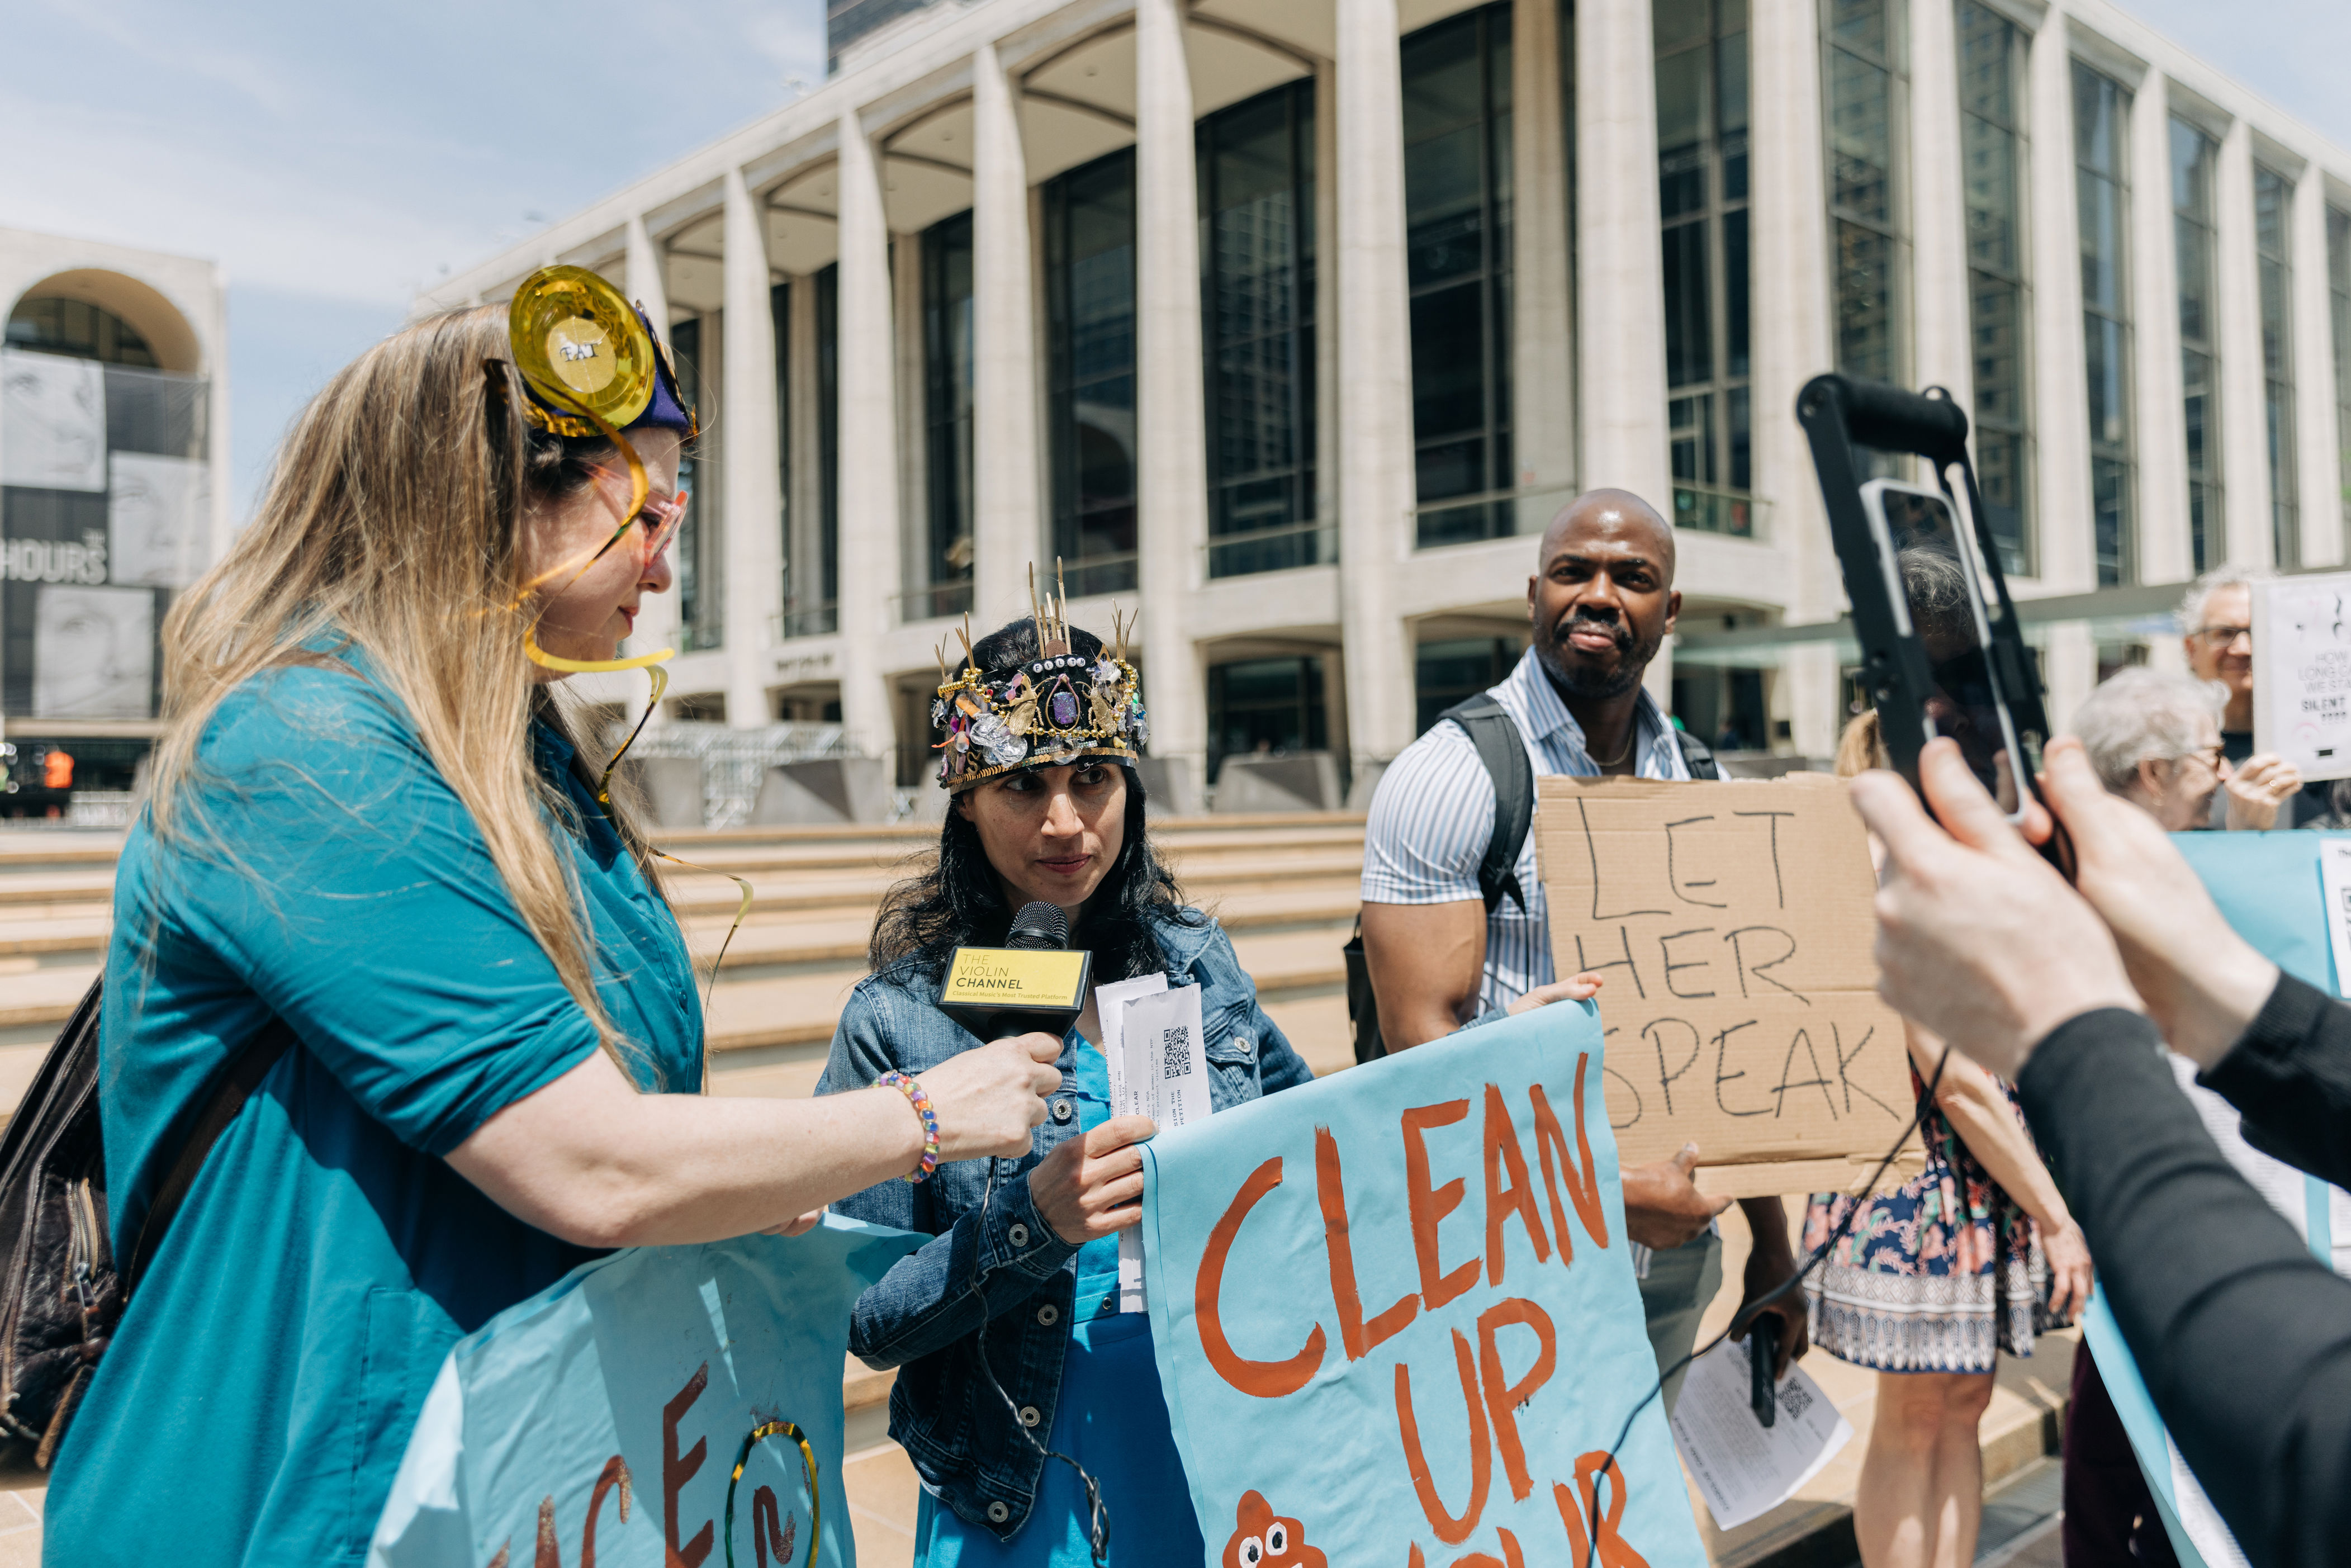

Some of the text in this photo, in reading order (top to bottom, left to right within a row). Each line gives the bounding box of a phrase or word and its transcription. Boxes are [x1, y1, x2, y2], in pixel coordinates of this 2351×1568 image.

[0, 538, 107, 585] HOURS
[1035, 659, 1084, 672] FILTH
[2301, 695, 2345, 712] SILENT
[1576, 796, 1795, 920] LET
[960, 966, 1009, 977] VIOLIN
[964, 954, 990, 965] THE
[1575, 925, 1811, 1006] HER
[956, 978, 1023, 989] CHANNEL
[1195, 1052, 1609, 1399] CLEAN
[1395, 1297, 1557, 1546] UP
